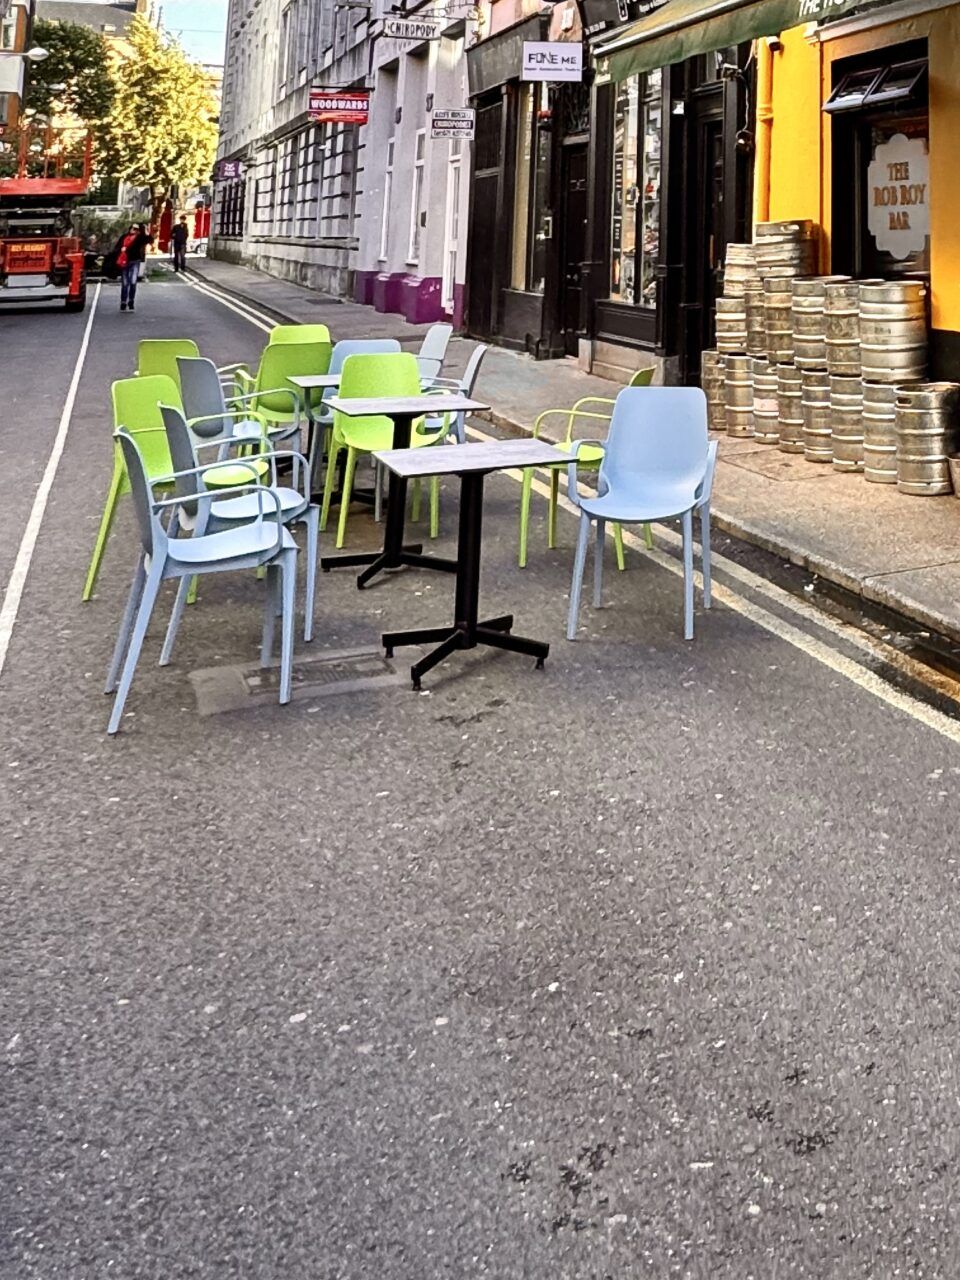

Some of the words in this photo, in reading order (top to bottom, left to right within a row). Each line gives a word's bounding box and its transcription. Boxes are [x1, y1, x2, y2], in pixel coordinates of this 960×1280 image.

[390, 22, 437, 37] CHIROPODY
[528, 52, 558, 65] FONE
[561, 56, 577, 64] ME
[311, 99, 367, 109] WOODWARDS
[887, 161, 909, 181] THE
[873, 185, 898, 207] ROB
[899, 183, 926, 205] ROY
[888, 211, 911, 230] BAR
